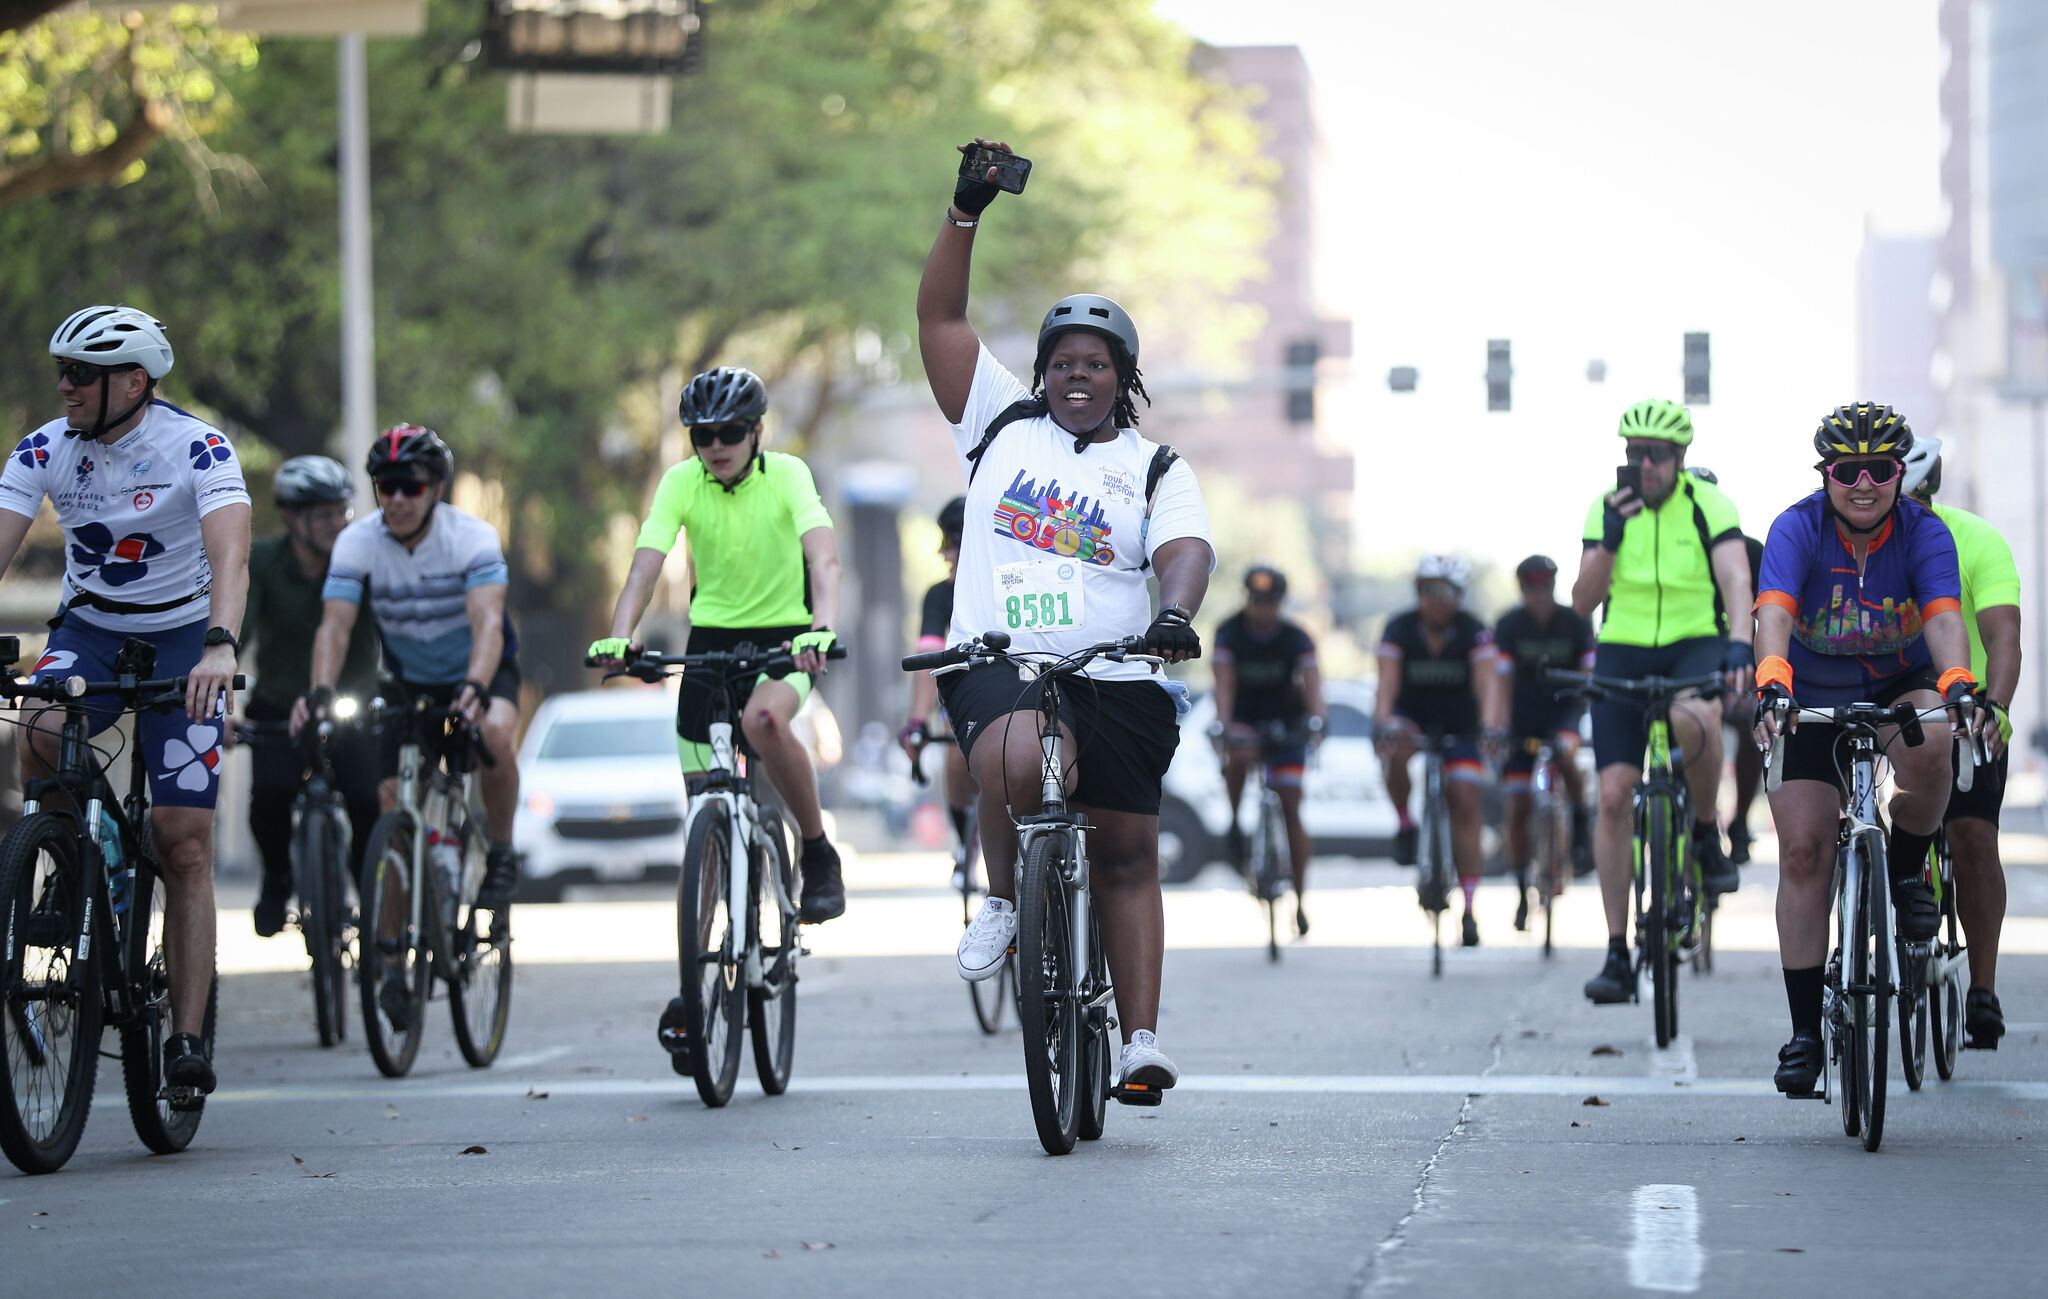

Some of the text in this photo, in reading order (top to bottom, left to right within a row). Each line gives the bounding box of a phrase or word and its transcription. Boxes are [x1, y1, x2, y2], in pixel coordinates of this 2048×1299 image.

[1103, 473, 1123, 485] TOUR
[1103, 480, 1135, 498] HOUSTON
[1006, 591, 1073, 629] 8581
